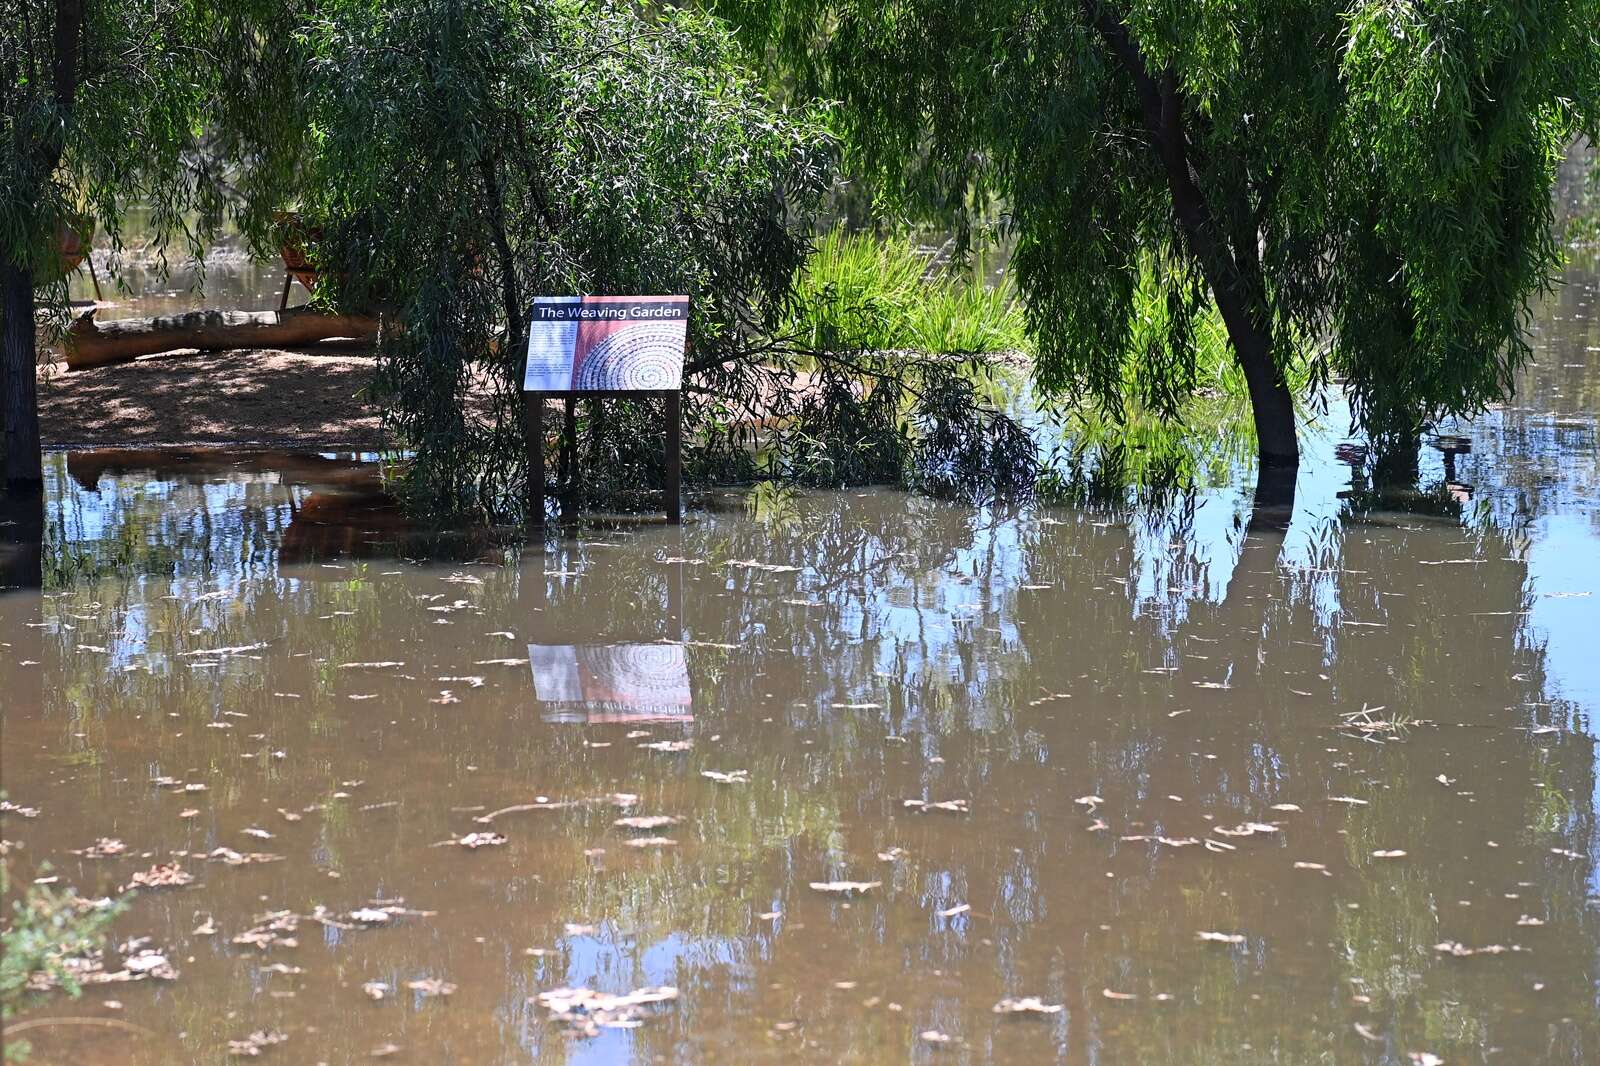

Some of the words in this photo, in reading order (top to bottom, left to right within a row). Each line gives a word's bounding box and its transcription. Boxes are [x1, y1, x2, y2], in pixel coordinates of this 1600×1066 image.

[539, 307, 565, 318] The
[568, 307, 627, 320] Weaving
[630, 306, 681, 317] Garden
